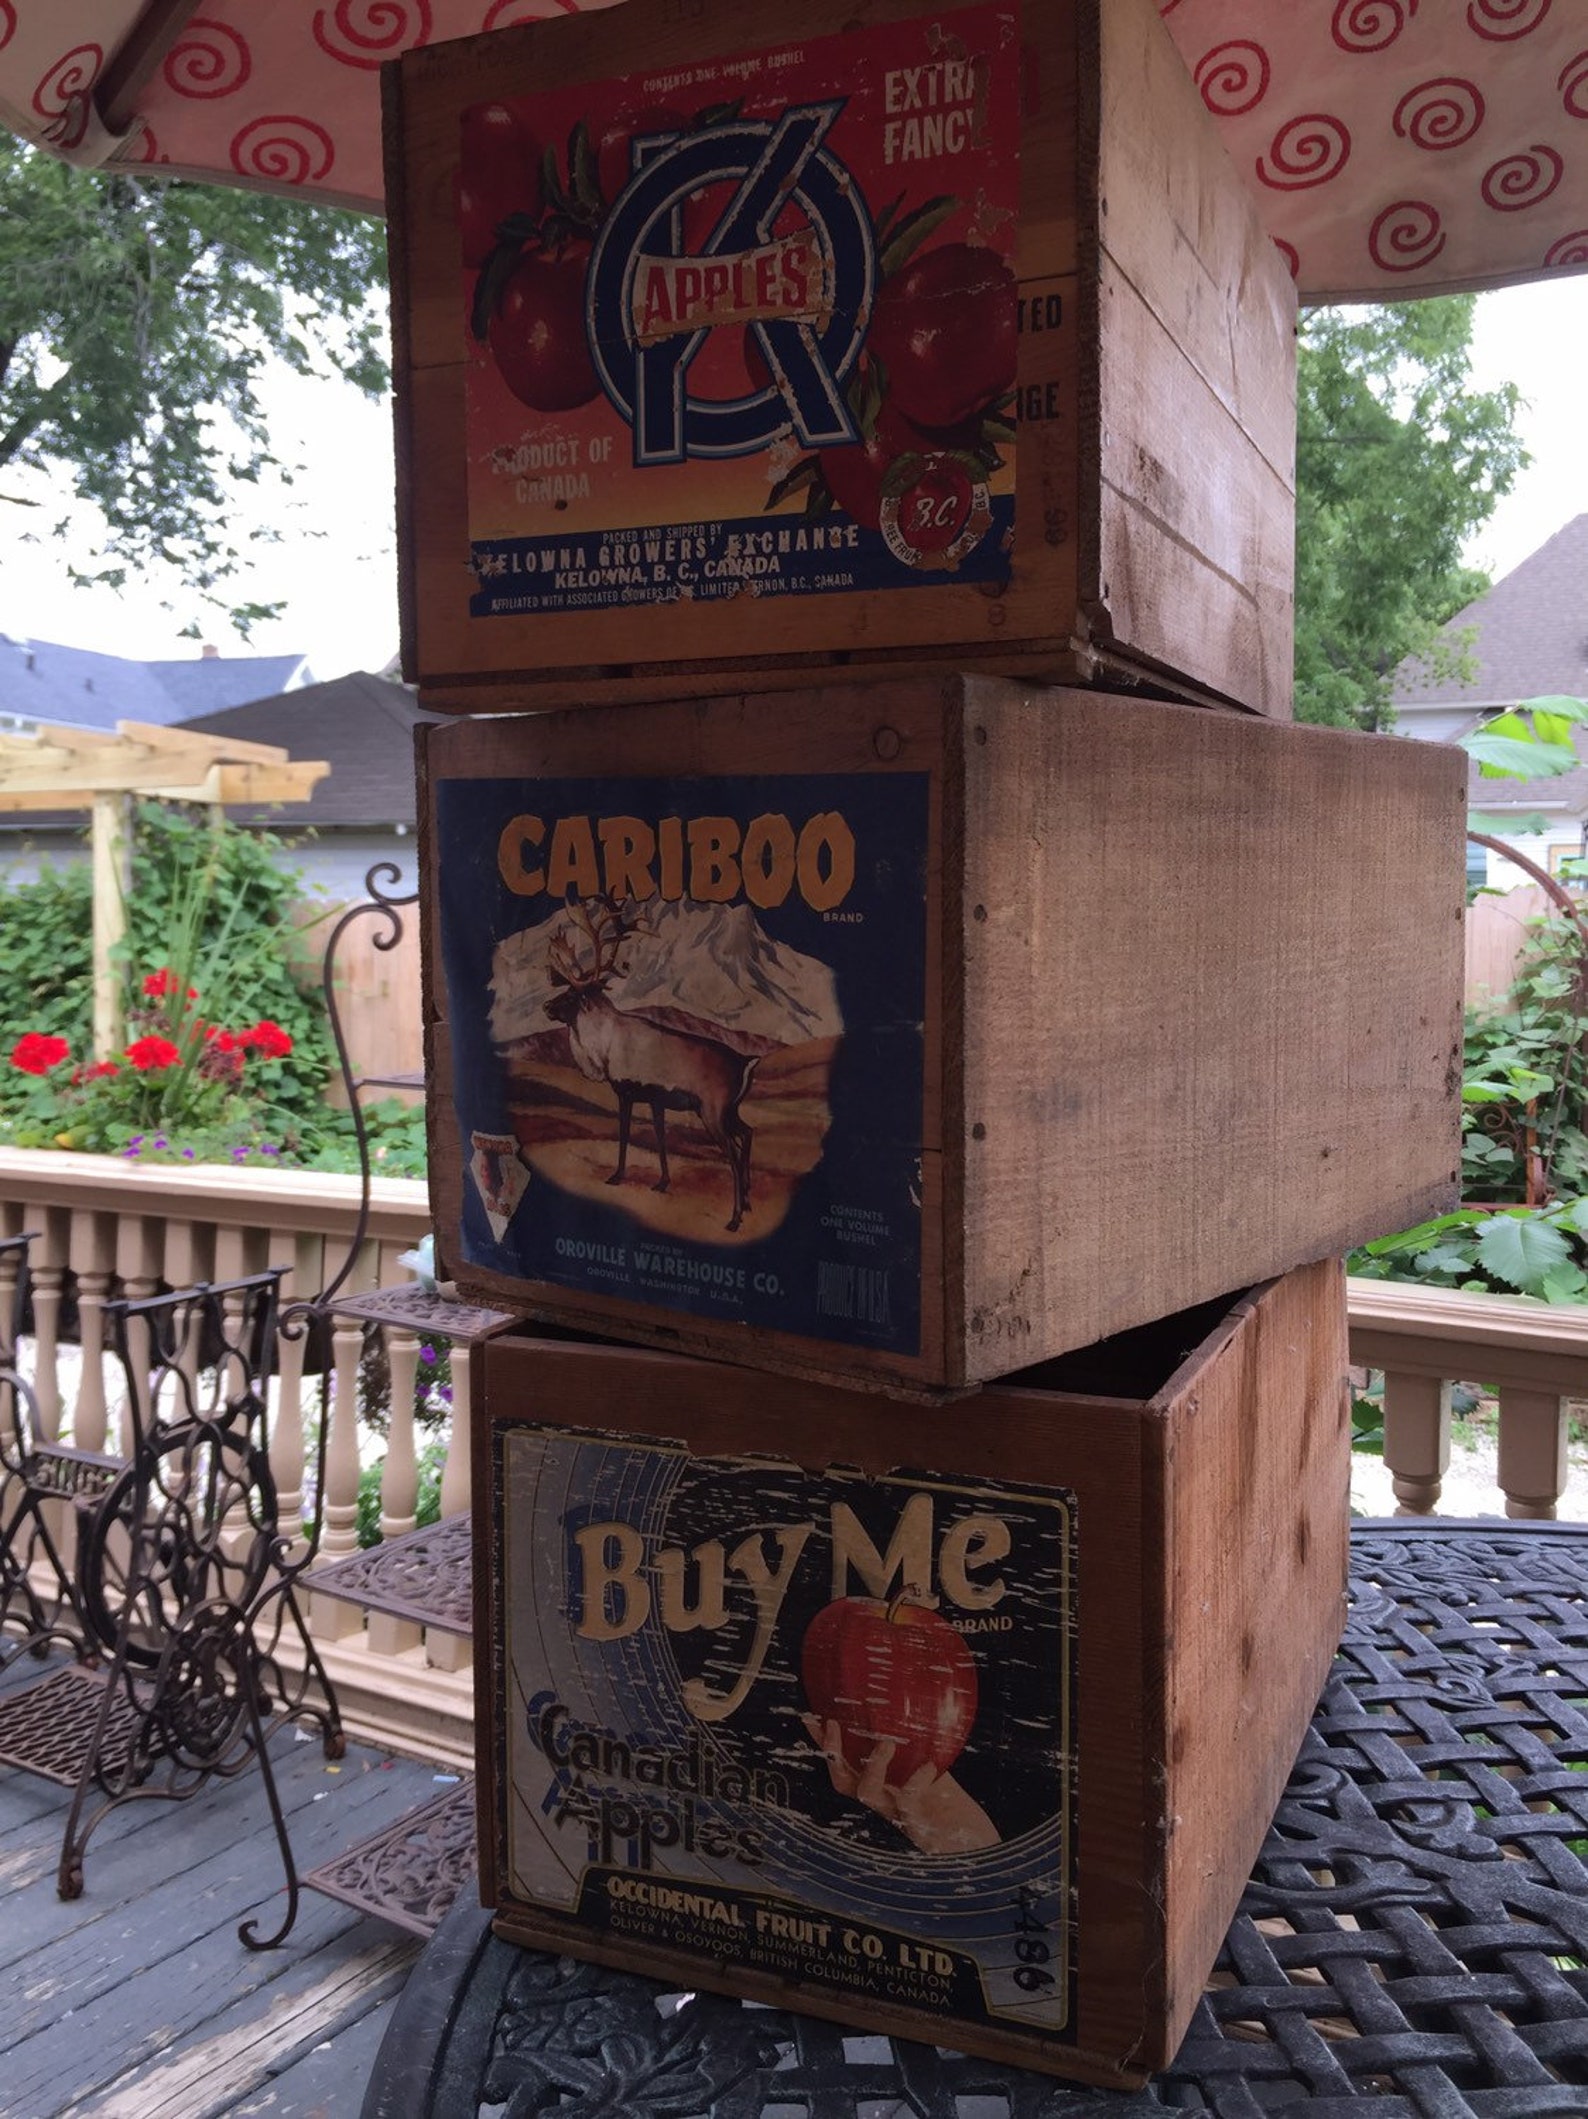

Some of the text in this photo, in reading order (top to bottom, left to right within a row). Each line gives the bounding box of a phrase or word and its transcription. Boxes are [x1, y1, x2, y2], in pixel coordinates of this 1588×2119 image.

[643, 250, 810, 333] APPLES
[589, 436, 613, 464] OF
[515, 472, 591, 504] CANADA
[914, 496, 958, 529] B.C.
[603, 523, 723, 545] PACKED AND SHIPPED BY
[726, 524, 859, 556] EXCHANGE
[555, 568, 648, 589] KELOWNA,
[704, 555, 781, 579] CANADA
[491, 596, 539, 611] AFFILIATED
[542, 594, 564, 608] WITH
[566, 590, 618, 606] ASSOCIATED
[621, 585, 663, 602] GROWERS
[497, 810, 856, 912] CARIBOO
[822, 912, 864, 924] BRAND
[820, 1216, 890, 1236] ONE VOLUME
[830, 1204, 883, 1222] CONTENTS
[836, 1230, 876, 1245] BUSHEL
[555, 1237, 626, 1266] OROVILLE
[633, 1251, 745, 1288] WAREHOUSE
[753, 1272, 785, 1296] CO.
[573, 1491, 1012, 1722] Buy Me
[951, 1616, 1014, 1634] BRAND
[538, 1704, 790, 1808] Canadian
[554, 1774, 765, 1870] Apples
[606, 1875, 957, 1977] OCCIDENTAL FRUIT CO. LTD.
[609, 1899, 684, 1928] KELOWNA,
[757, 1936, 860, 1971] SUMMERLAND,
[868, 1960, 953, 1993] PENTICTON,
[610, 1915, 655, 1935] OLIVER
[750, 1948, 798, 1971] BRITISH
[804, 1962, 879, 1993] COLUMBIA,
